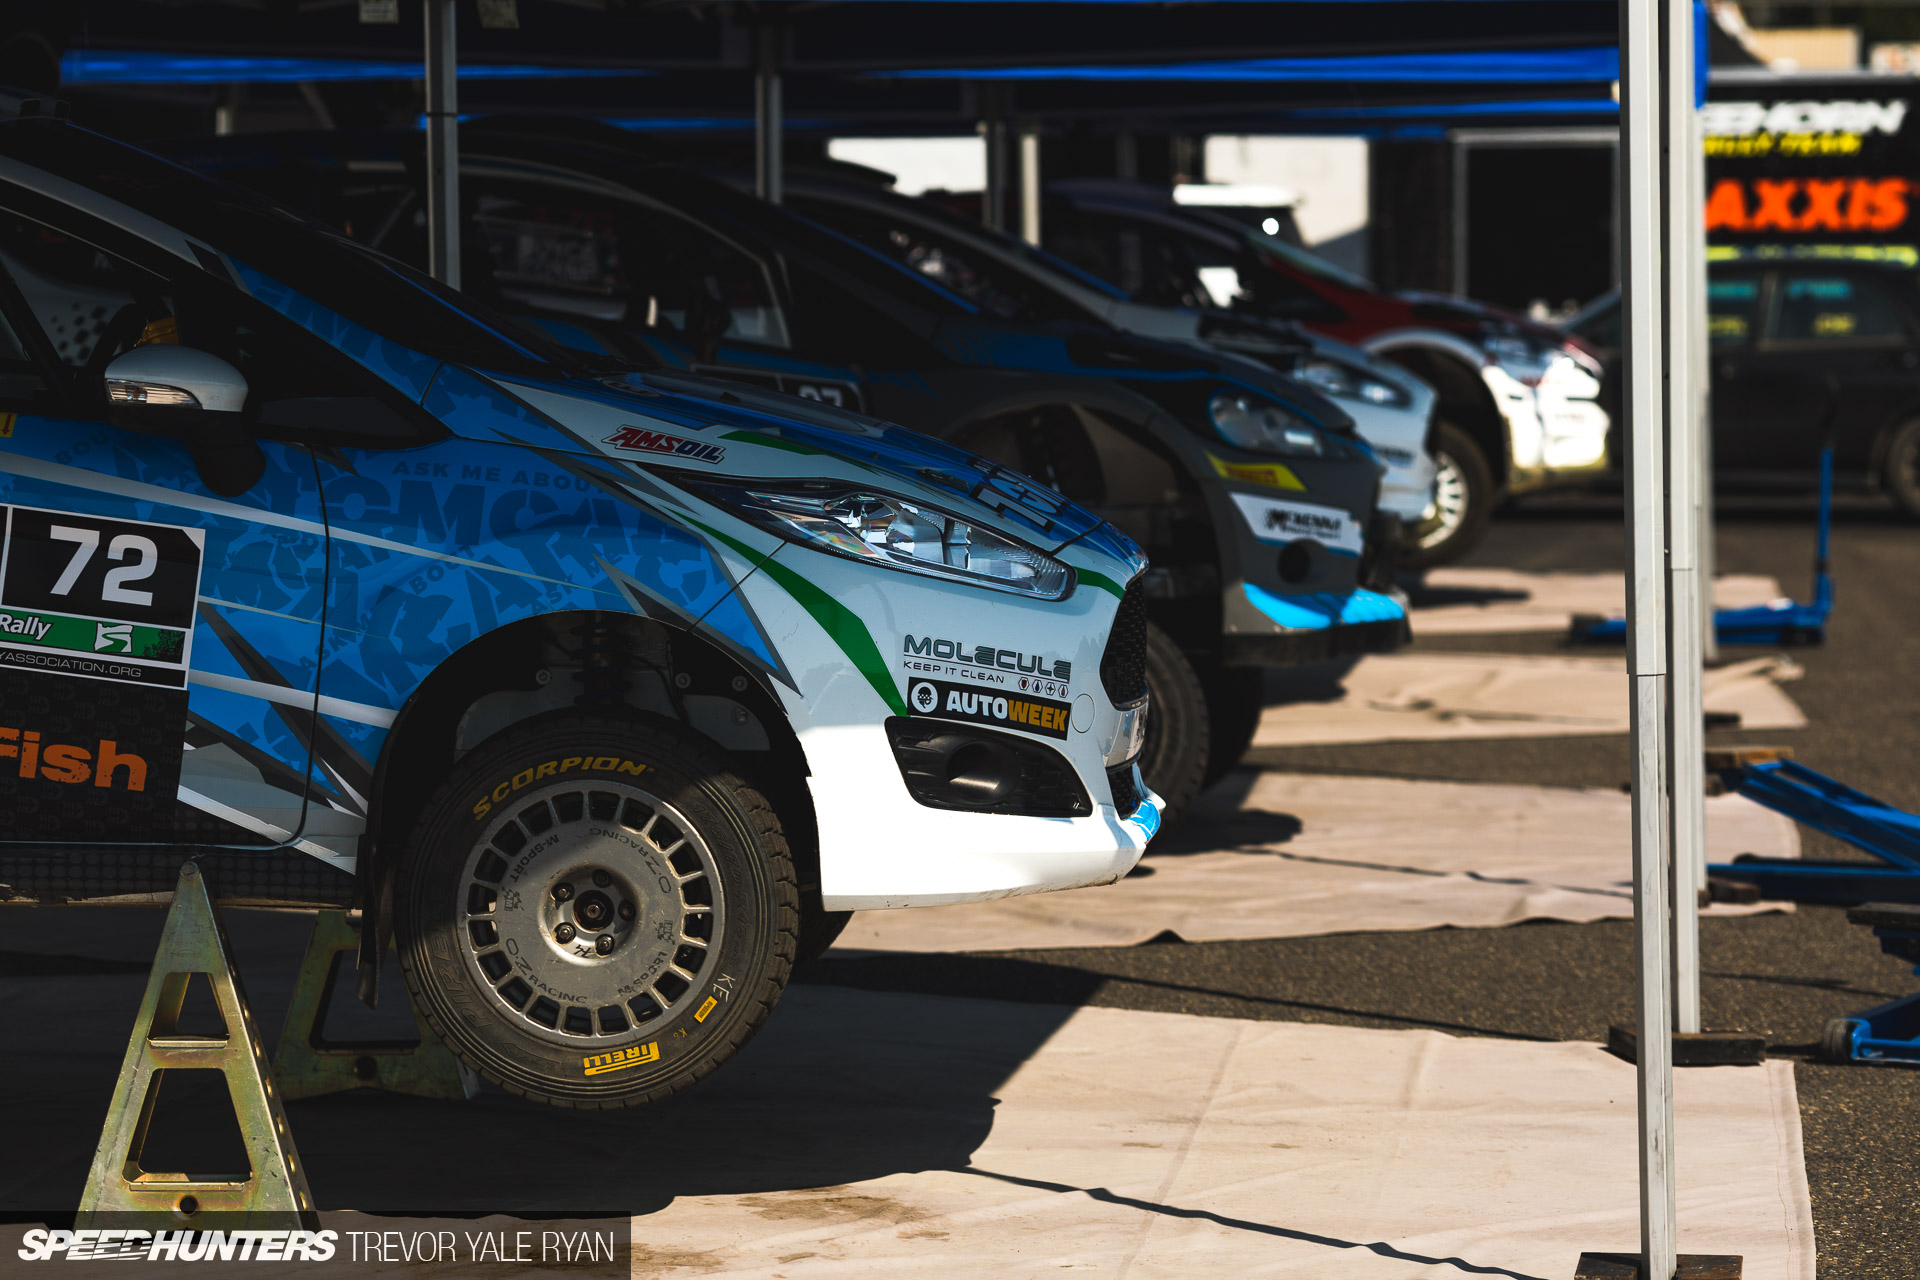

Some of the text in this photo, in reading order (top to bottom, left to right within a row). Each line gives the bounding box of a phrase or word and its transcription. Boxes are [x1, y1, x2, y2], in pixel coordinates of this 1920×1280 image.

[606, 426, 723, 462] AMSOIL
[391, 460, 604, 495] ASK ME ABOU
[50, 524, 159, 607] 72
[0, 613, 52, 641] Rally
[903, 660, 1005, 684] KEEP IT CLEAN
[904, 634, 1072, 682] MOLECULE
[946, 690, 1068, 732] AUTOWEEK
[473, 756, 647, 821] SCORPION
[589, 827, 649, 858] RACING
[583, 1041, 661, 1077] PIRELLI
